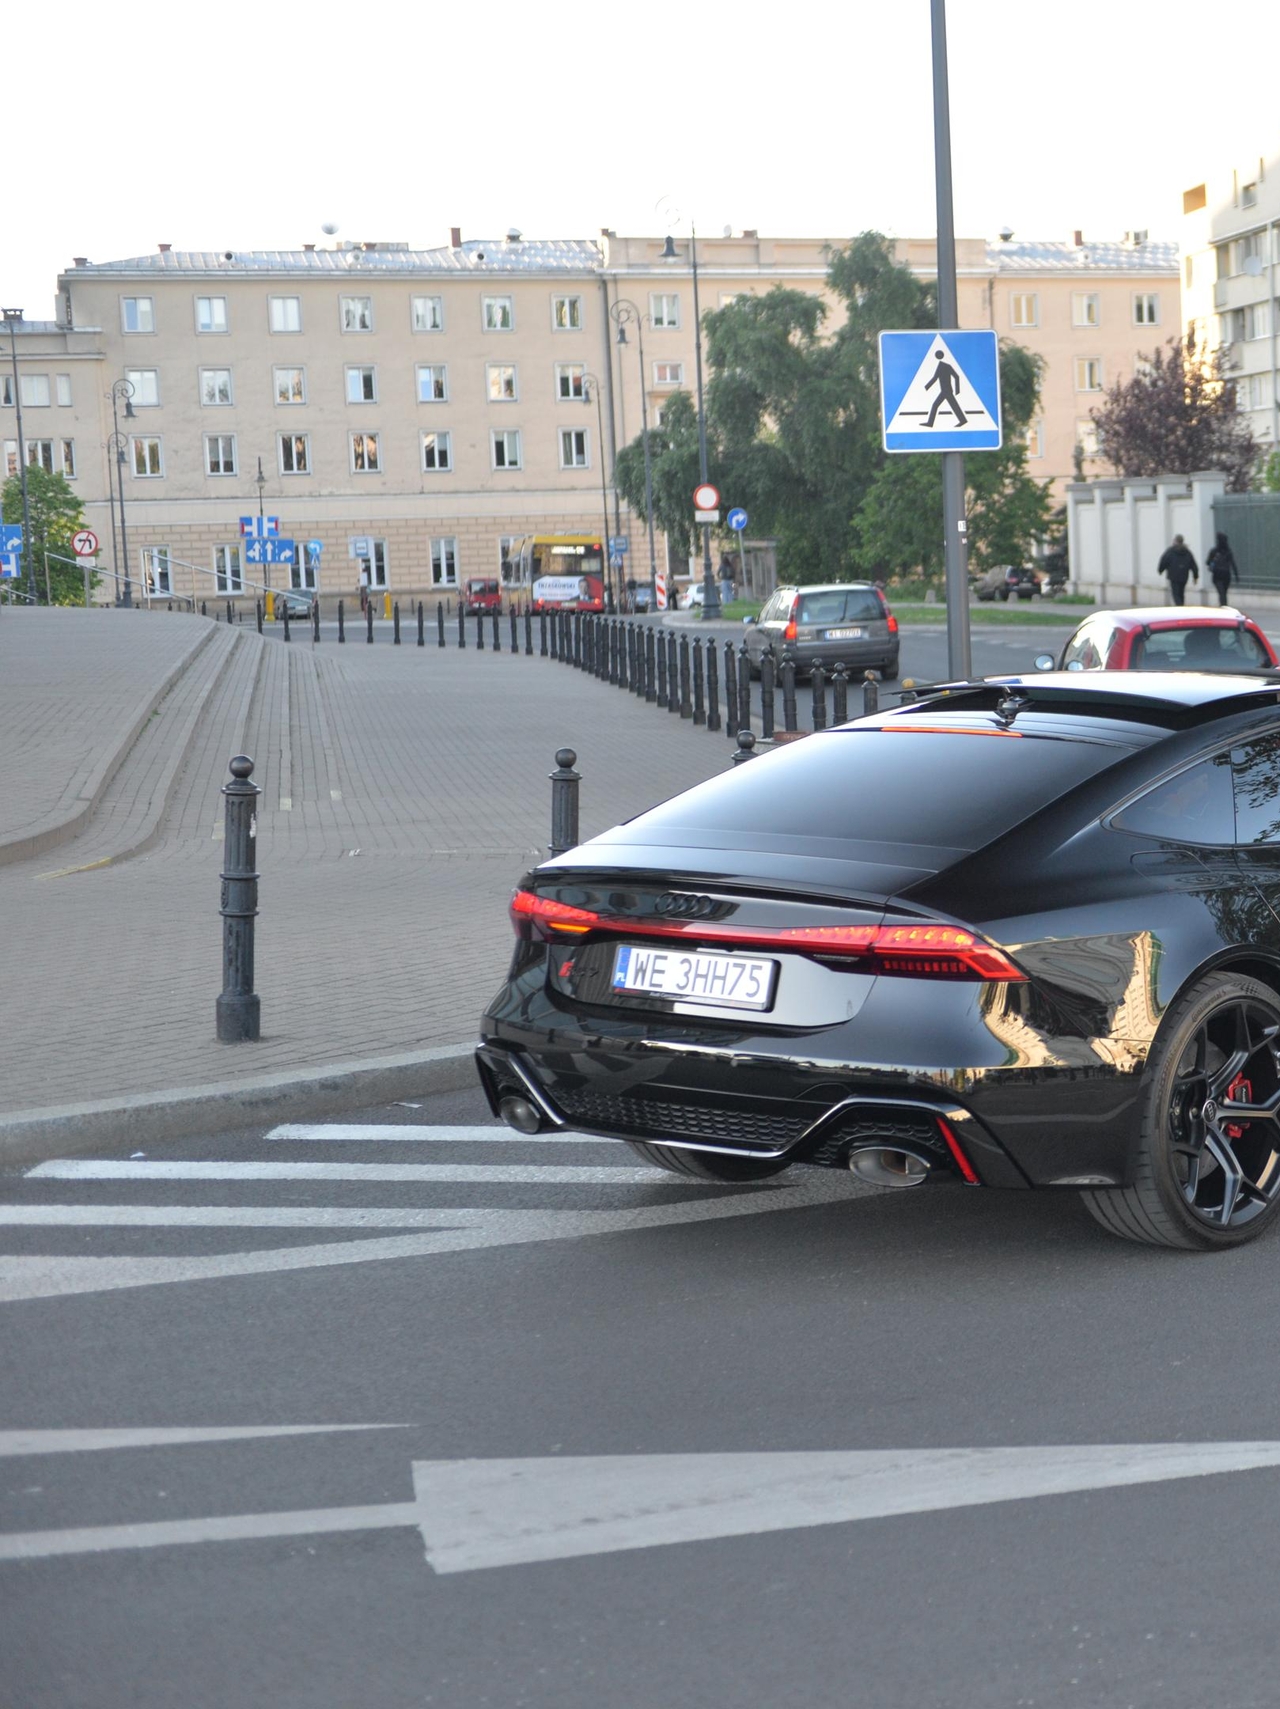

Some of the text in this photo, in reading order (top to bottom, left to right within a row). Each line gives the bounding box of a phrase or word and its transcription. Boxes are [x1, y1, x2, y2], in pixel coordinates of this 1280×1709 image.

[615, 972, 626, 982] PL
[633, 953, 763, 998] WE 3HH75
